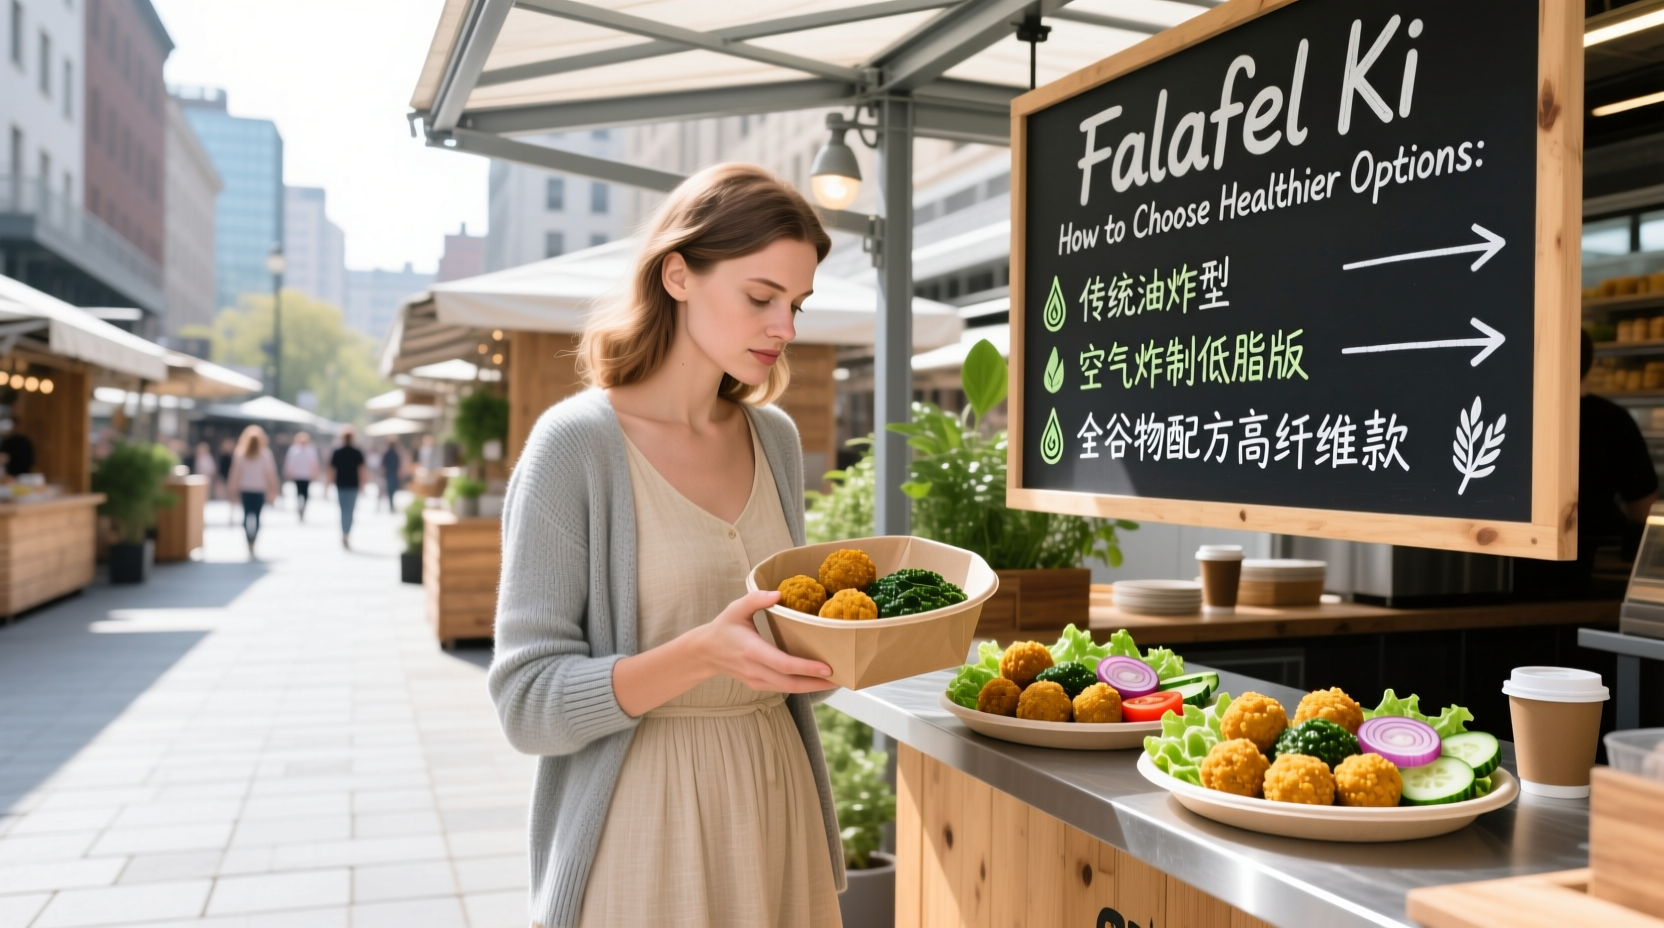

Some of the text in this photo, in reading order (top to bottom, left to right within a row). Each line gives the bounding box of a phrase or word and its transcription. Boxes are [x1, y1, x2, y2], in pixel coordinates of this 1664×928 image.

[1077, 14, 1424, 207] Falafel Ki
[1058, 140, 1485, 256] How to Choose Healthier Options:
[1078, 255, 1230, 323] 传统油炸型
[1079, 328, 1309, 391] 空气炸制低脂版
[1077, 408, 1411, 472] 全谷物配方高纤维款
